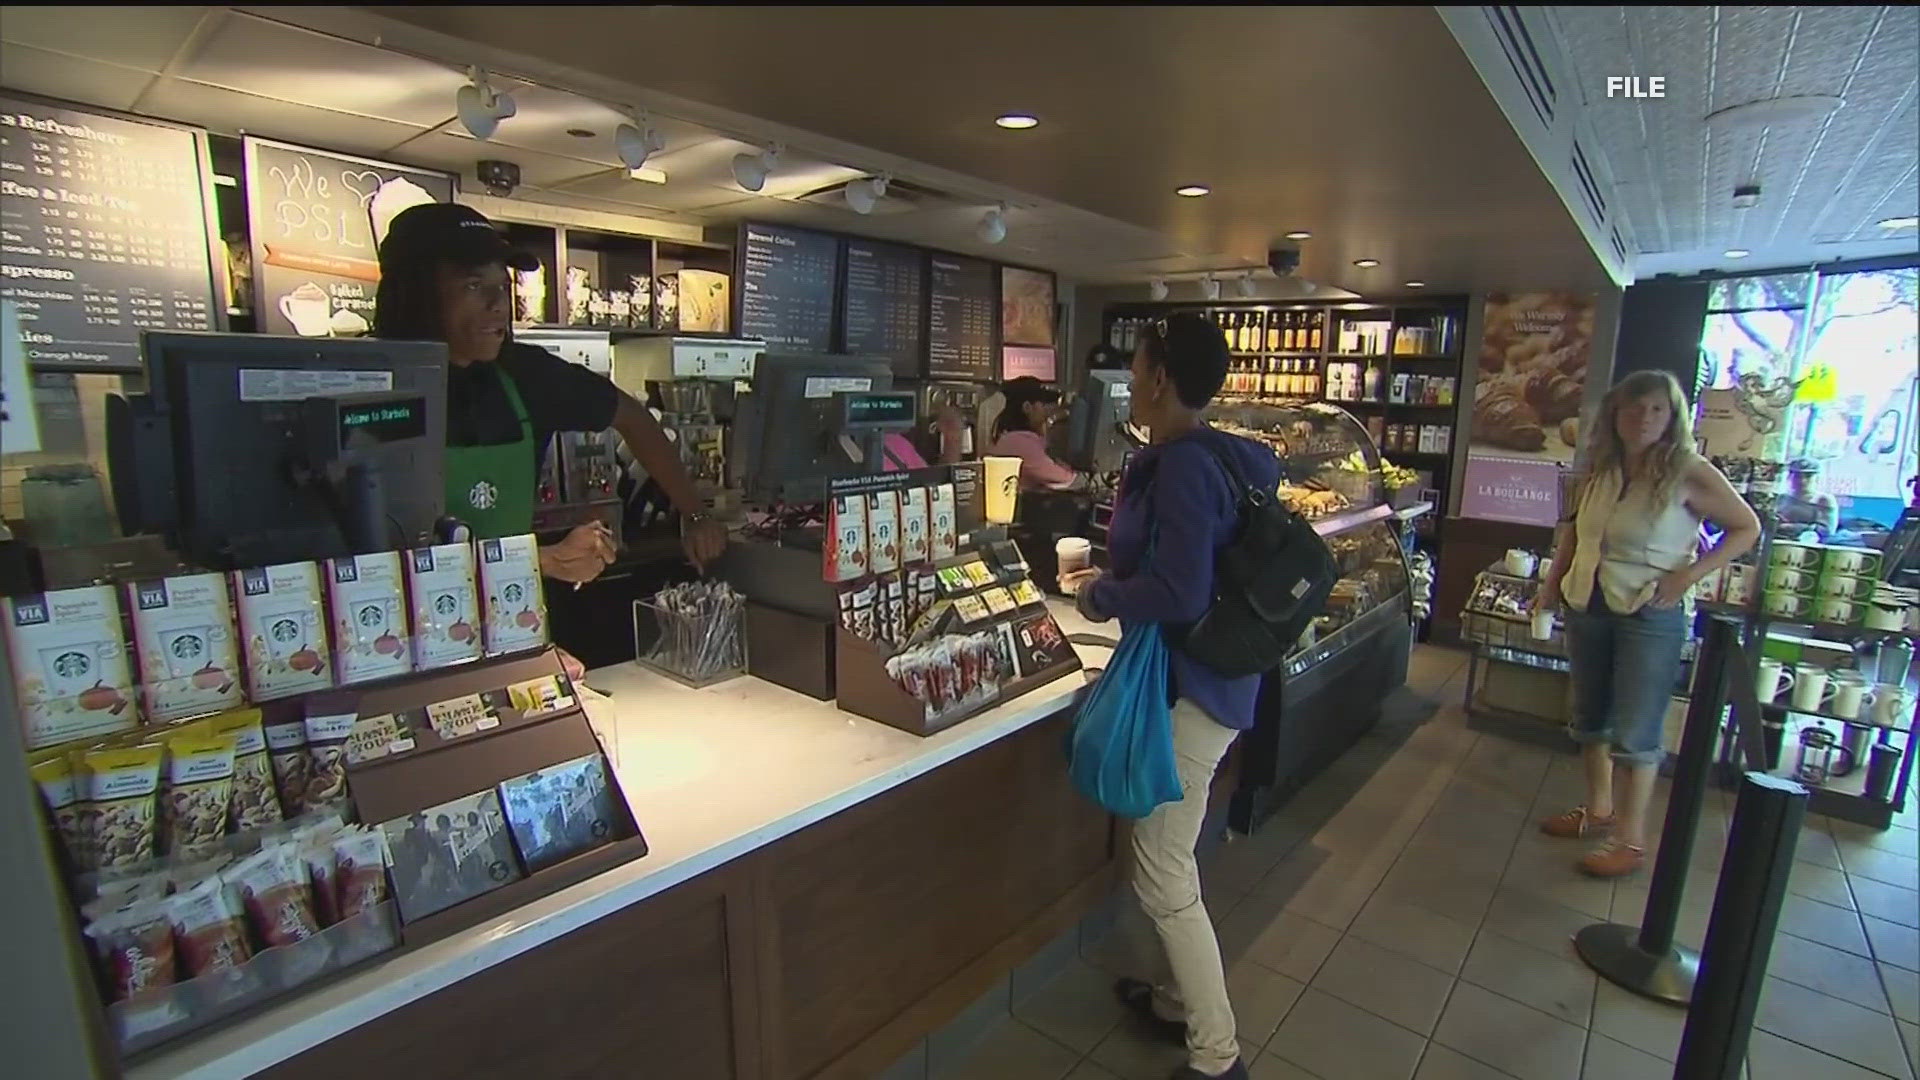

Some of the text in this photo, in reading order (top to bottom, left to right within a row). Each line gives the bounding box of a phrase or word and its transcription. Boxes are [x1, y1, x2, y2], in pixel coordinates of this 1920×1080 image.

[269, 156, 331, 199] We
[276, 200, 365, 248] PSL
[29, 350, 110, 362] Orange Mango
[1478, 485, 1493, 497] LA
[246, 578, 266, 591] VIA
[141, 591, 163, 604] VIA
[17, 607, 43, 621] VIA
[188, 761, 227, 773] Almonds
[105, 778, 150, 790] Almonds
